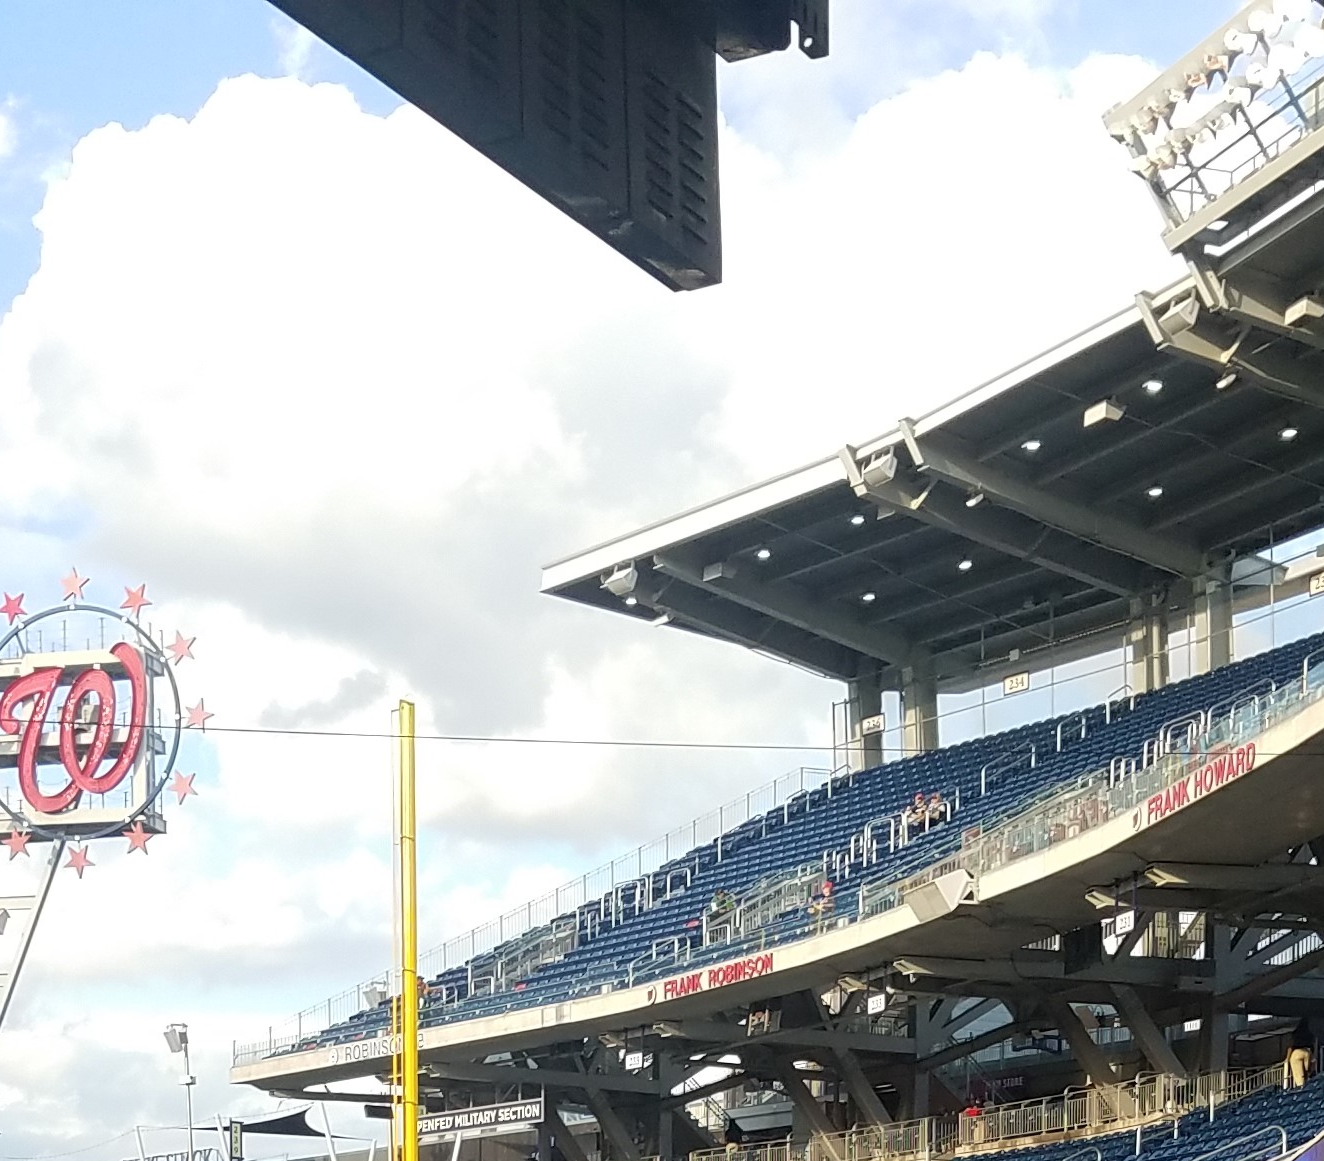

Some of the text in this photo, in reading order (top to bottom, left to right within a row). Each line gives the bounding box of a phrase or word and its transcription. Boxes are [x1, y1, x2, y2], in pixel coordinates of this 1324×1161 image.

[1146, 743, 1257, 825] FRANK HOWARD
[662, 953, 774, 1001] FRANK ROBINSON
[417, 1104, 541, 1133] PENFED MILITARY SECTION
